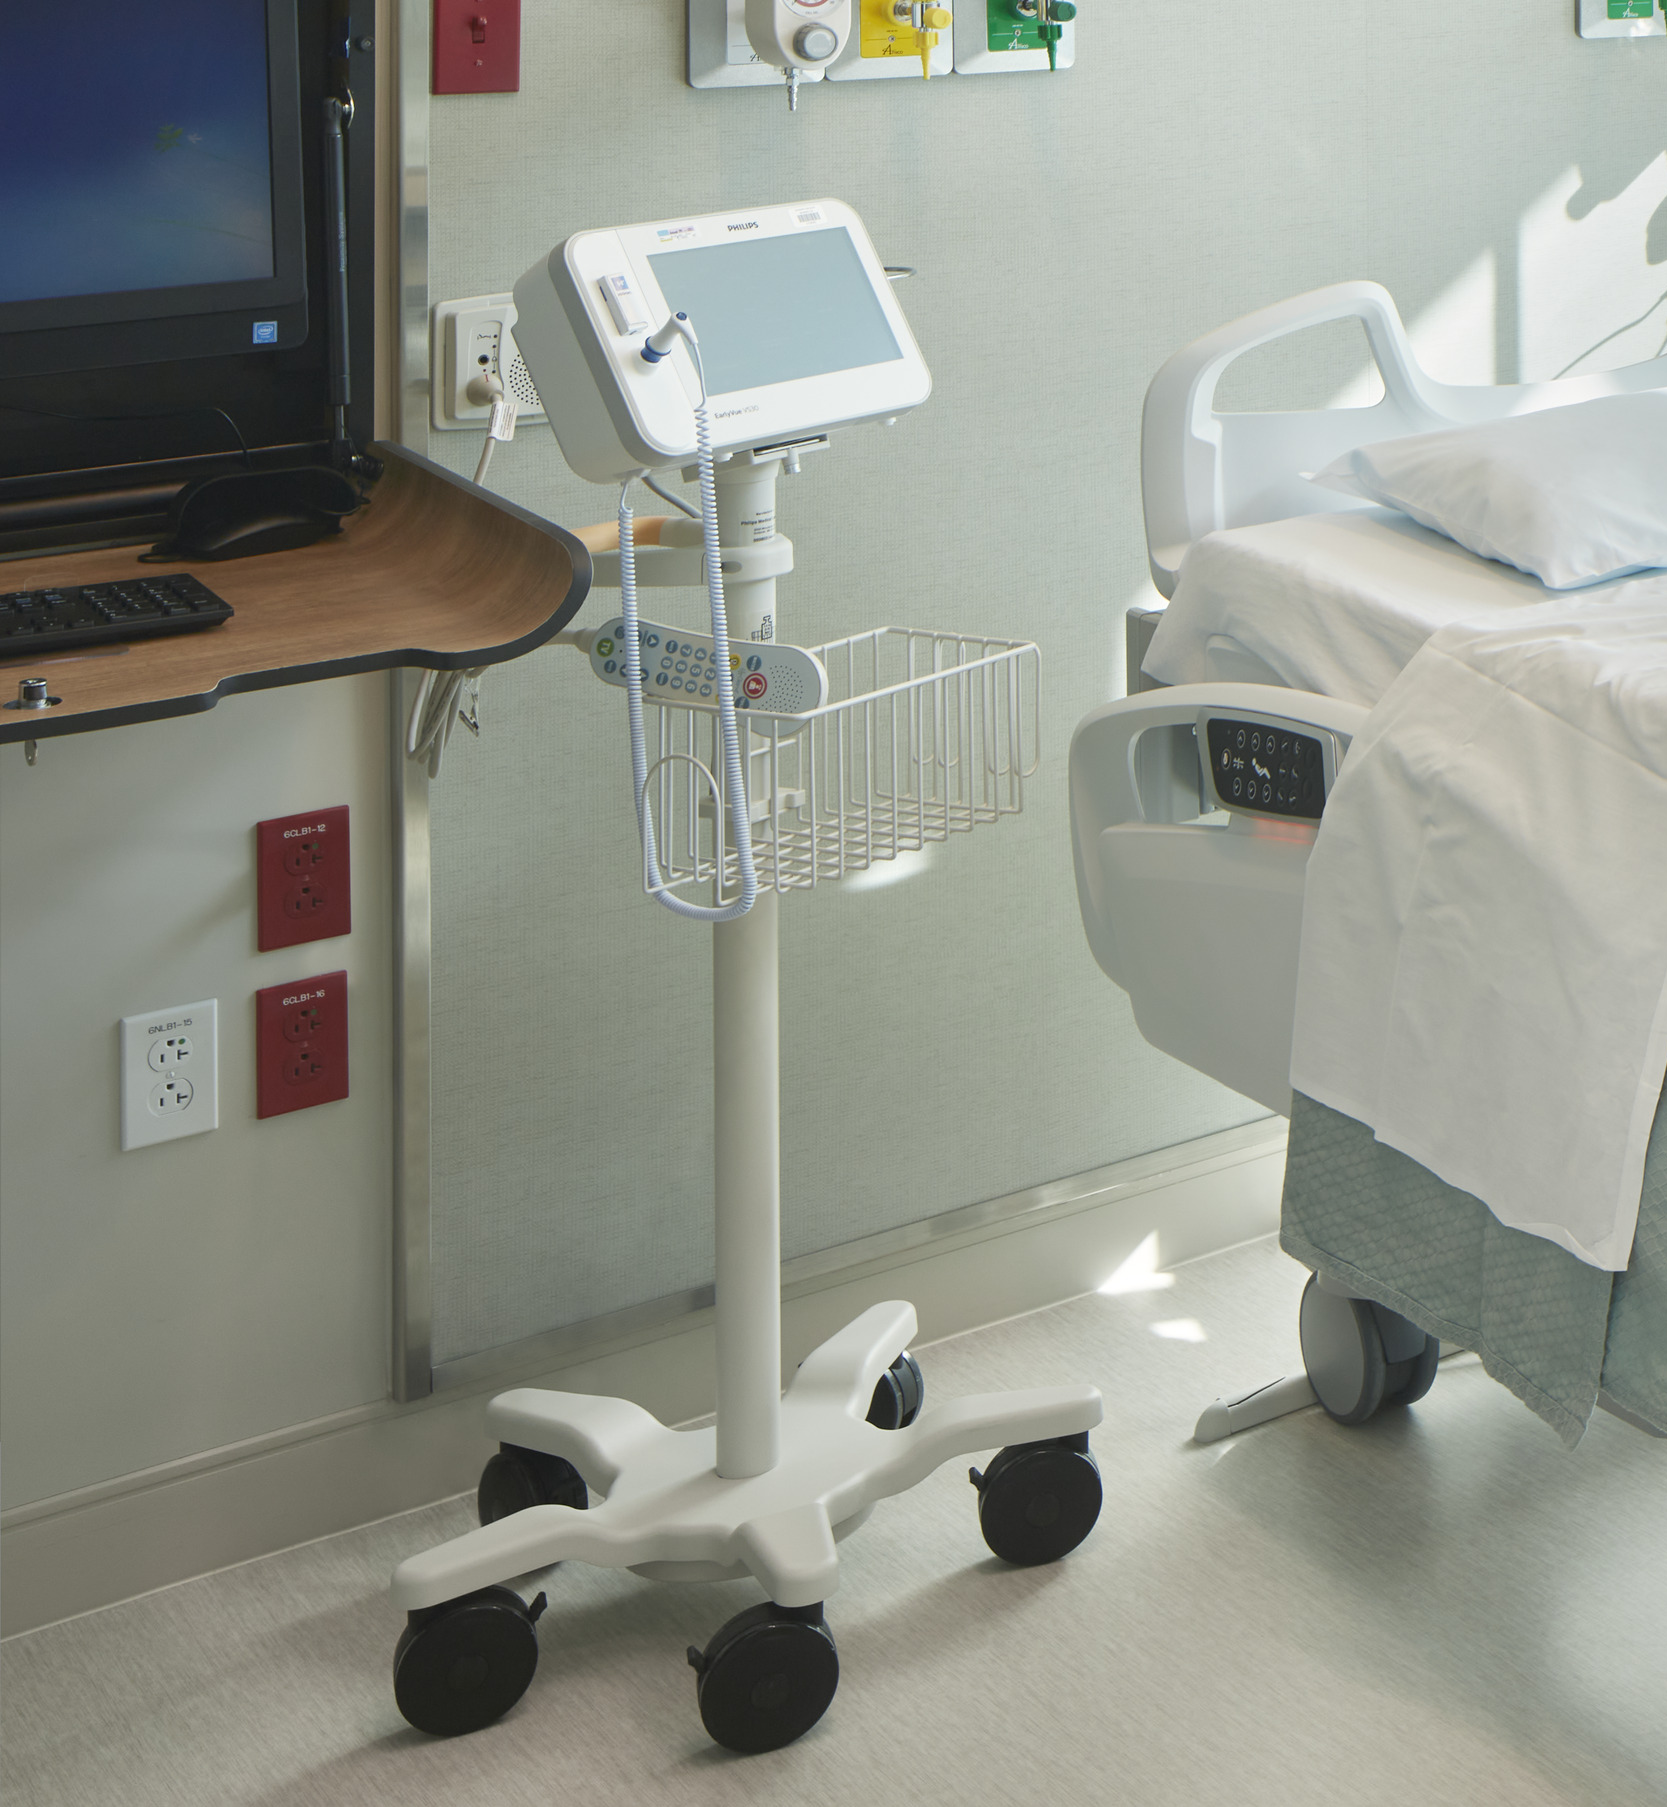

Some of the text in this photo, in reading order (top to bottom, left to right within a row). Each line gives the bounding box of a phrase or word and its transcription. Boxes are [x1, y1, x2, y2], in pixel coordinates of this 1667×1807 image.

[727, 221, 759, 232] PHILIPS
[600, 641, 611, 654] TV
[283, 824, 326, 838] 6CLB1-12
[283, 989, 325, 1005] 6CLB1-16
[148, 1018, 192, 1034] 6NLB1-15
